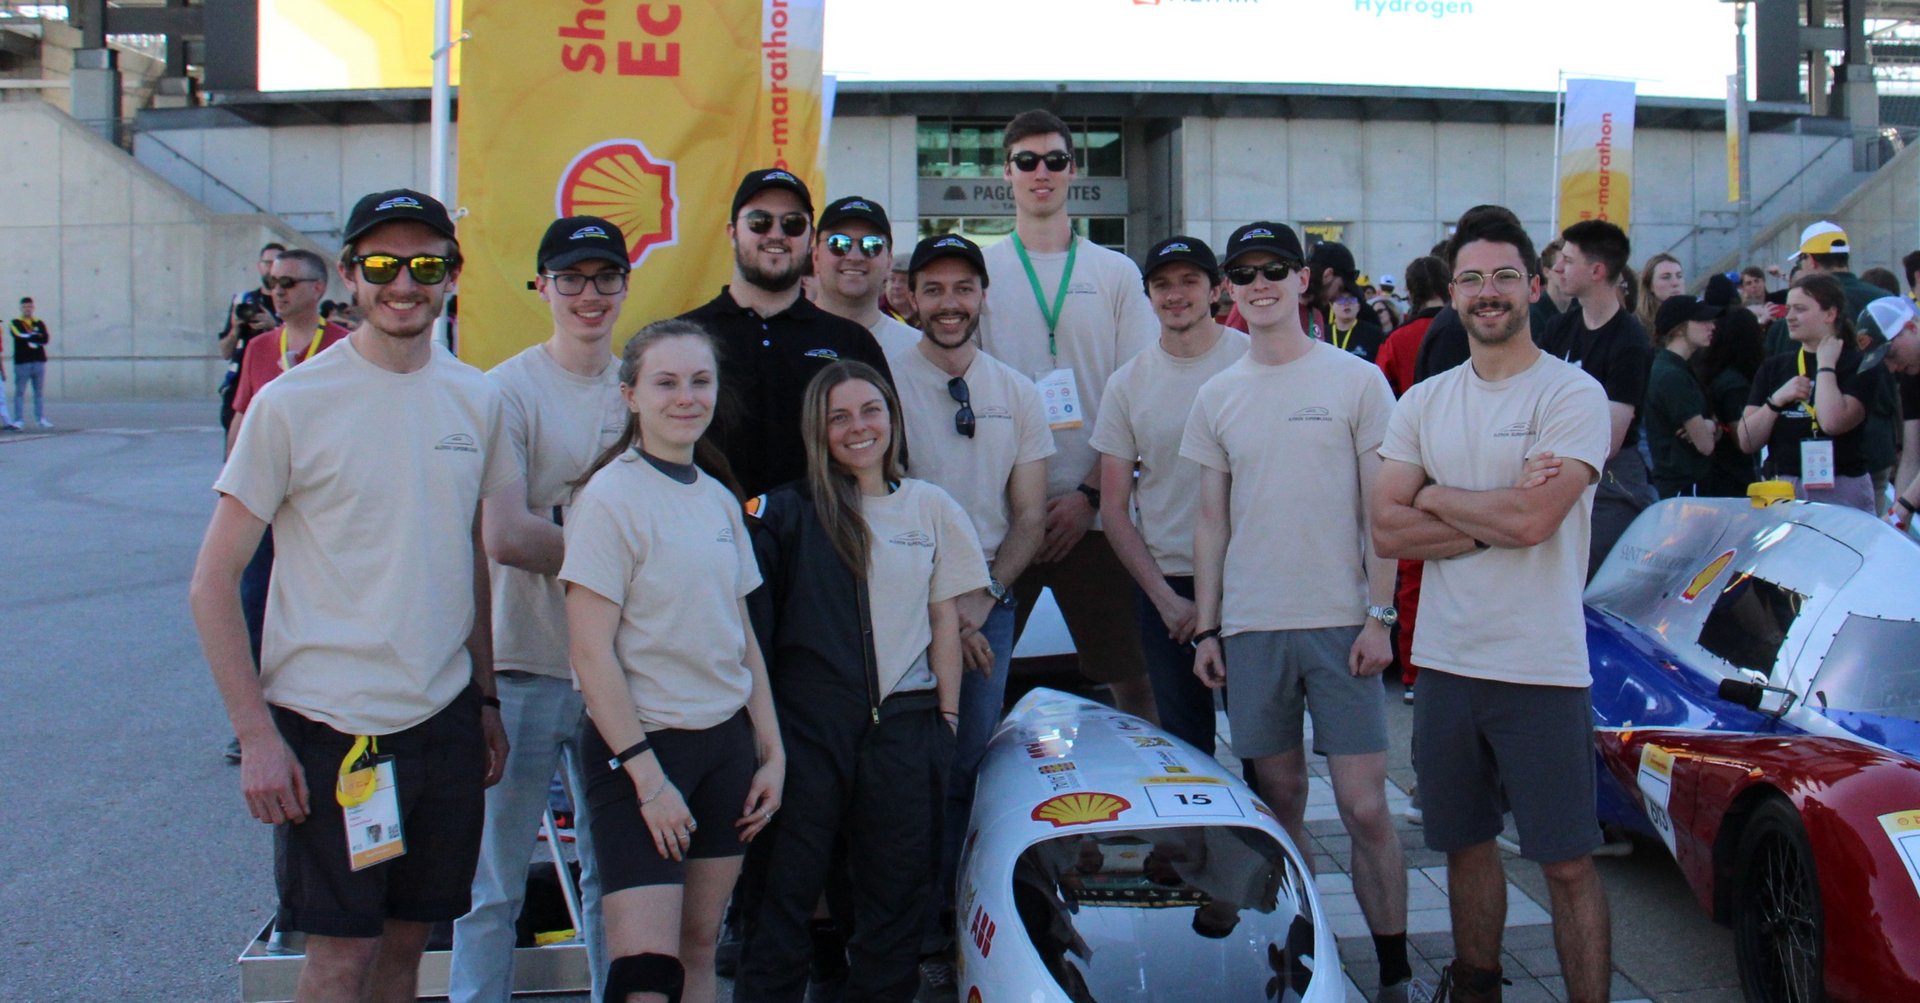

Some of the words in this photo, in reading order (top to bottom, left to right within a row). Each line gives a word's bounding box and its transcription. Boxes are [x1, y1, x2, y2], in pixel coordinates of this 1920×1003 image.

[1355, 0, 1473, 18] Hydrogen
[558, 0, 606, 74] Sh
[1174, 794, 1212, 805] 15
[970, 904, 996, 959] ABB
